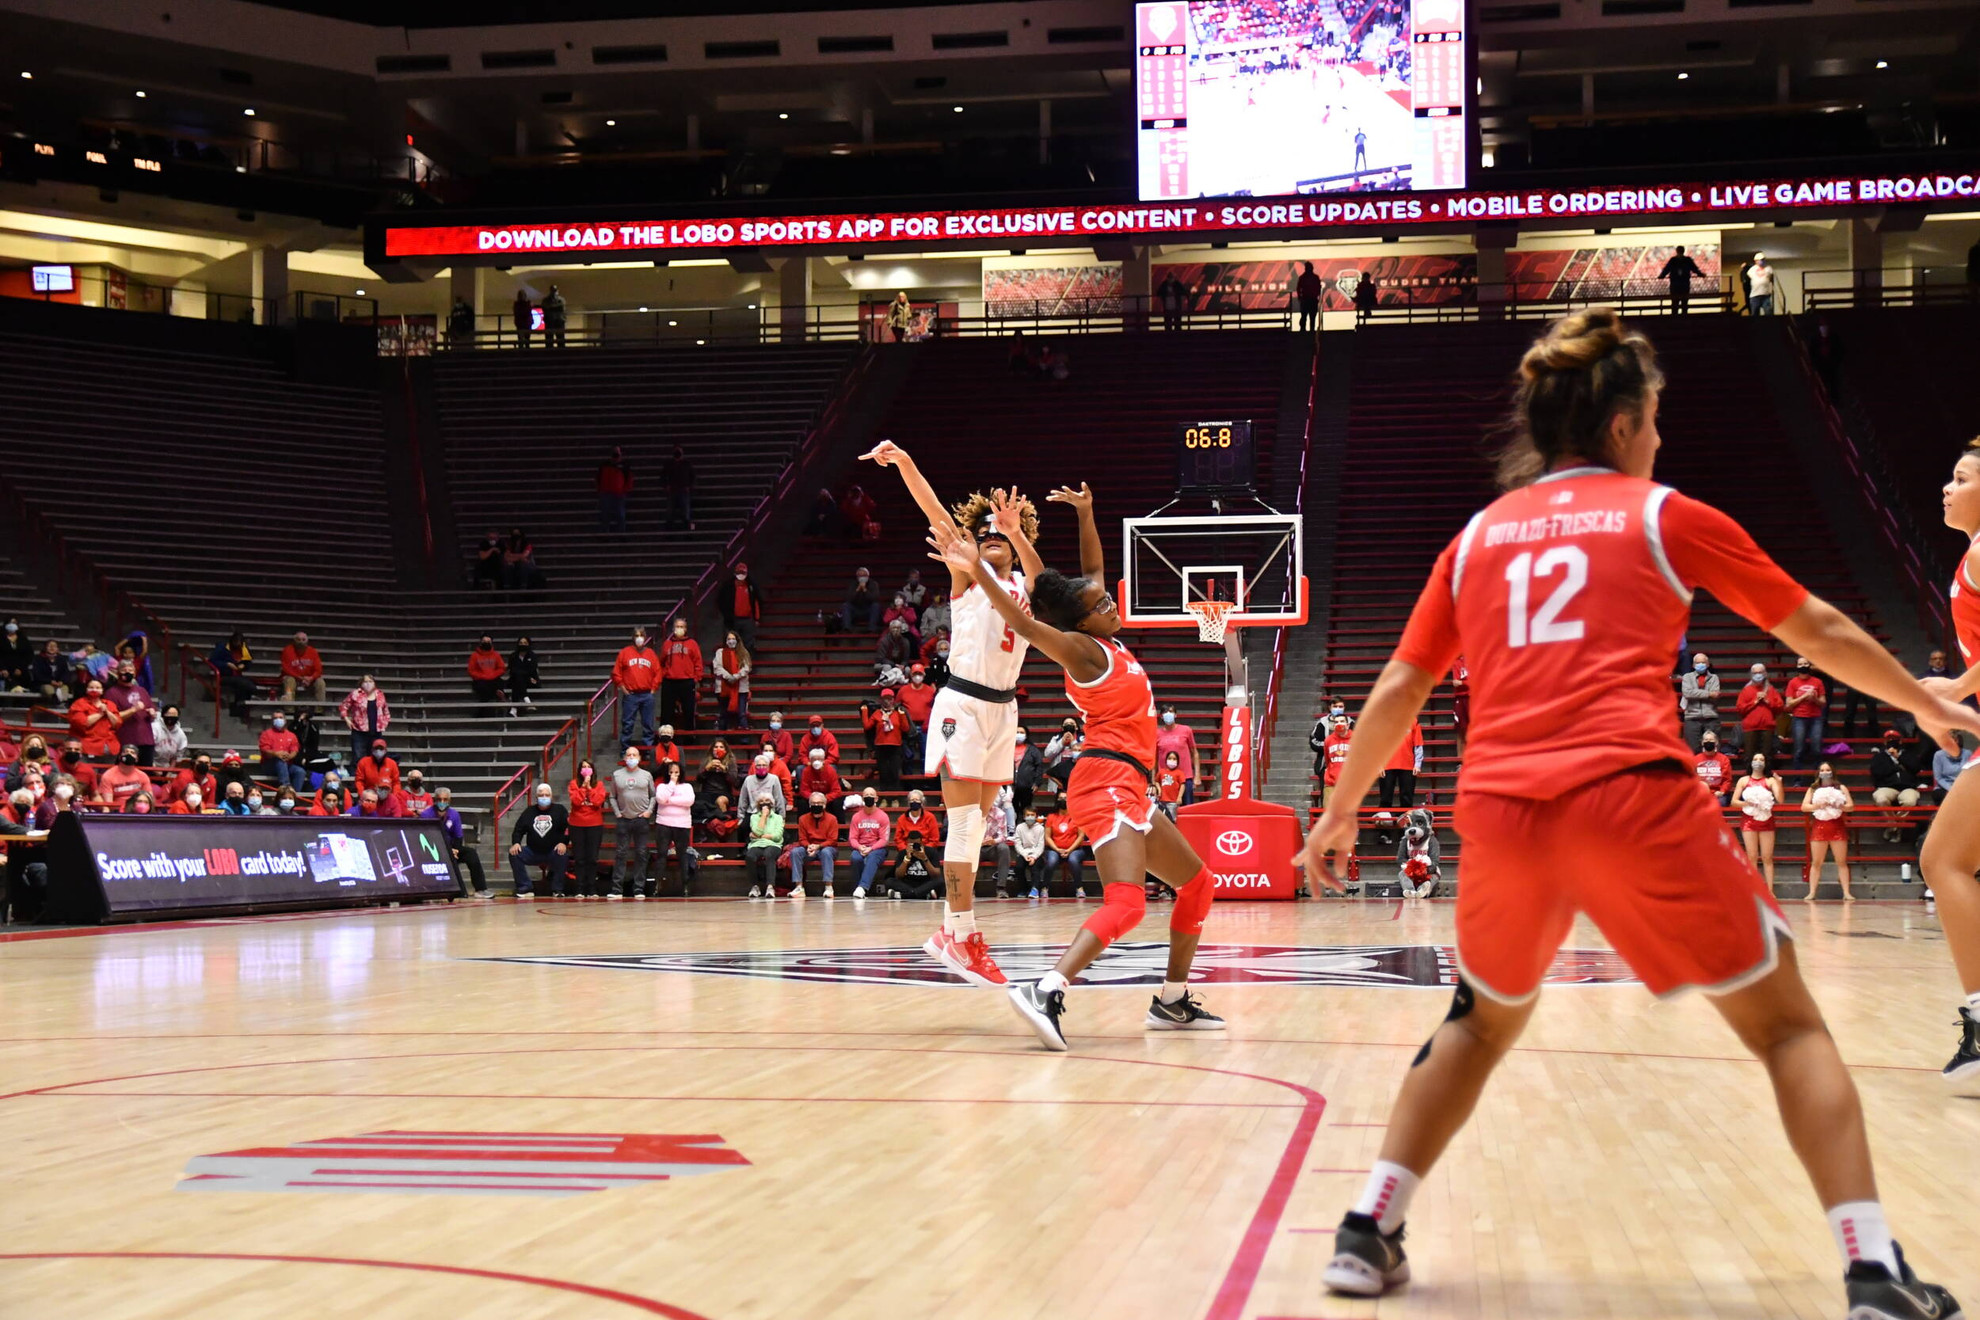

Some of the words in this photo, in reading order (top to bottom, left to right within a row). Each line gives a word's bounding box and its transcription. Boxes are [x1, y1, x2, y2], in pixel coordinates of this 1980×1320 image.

[478, 228, 614, 250] DOWNLOAD
[619, 226, 664, 245] THE
[670, 223, 734, 243] LOBO
[740, 221, 831, 240] SPORTS
[837, 219, 884, 239] APP
[891, 217, 938, 236] FOR
[945, 212, 1075, 235] EXCLUSIVE
[1081, 208, 1197, 230] CONTENT
[1221, 204, 1303, 225] SCORE
[1310, 200, 1422, 222] UPDATES
[1448, 195, 1543, 217] MOBILE
[1549, 189, 1682, 213] ORDERING
[1711, 185, 1767, 206] LIVE
[1775, 181, 1851, 203] GAME
[1207, 283, 1242, 293] MILE
[1251, 282, 1287, 291] HIGH
[1371, 278, 1430, 287] OUDER
[1440, 276, 1479, 285] THAN
[1186, 428, 1231, 449] 06.8
[1484, 510, 1627, 547] DURAZO-FRESCAS
[1505, 545, 1588, 648] 12
[1228, 708, 1243, 800] LOBOS
[97, 853, 143, 880] Score
[142, 852, 177, 879] with
[174, 858, 207, 882] your
[204, 849, 240, 876] LOBO
[241, 851, 271, 875] card
[267, 850, 307, 878] today!
[1213, 873, 1270, 888] OYOTA
